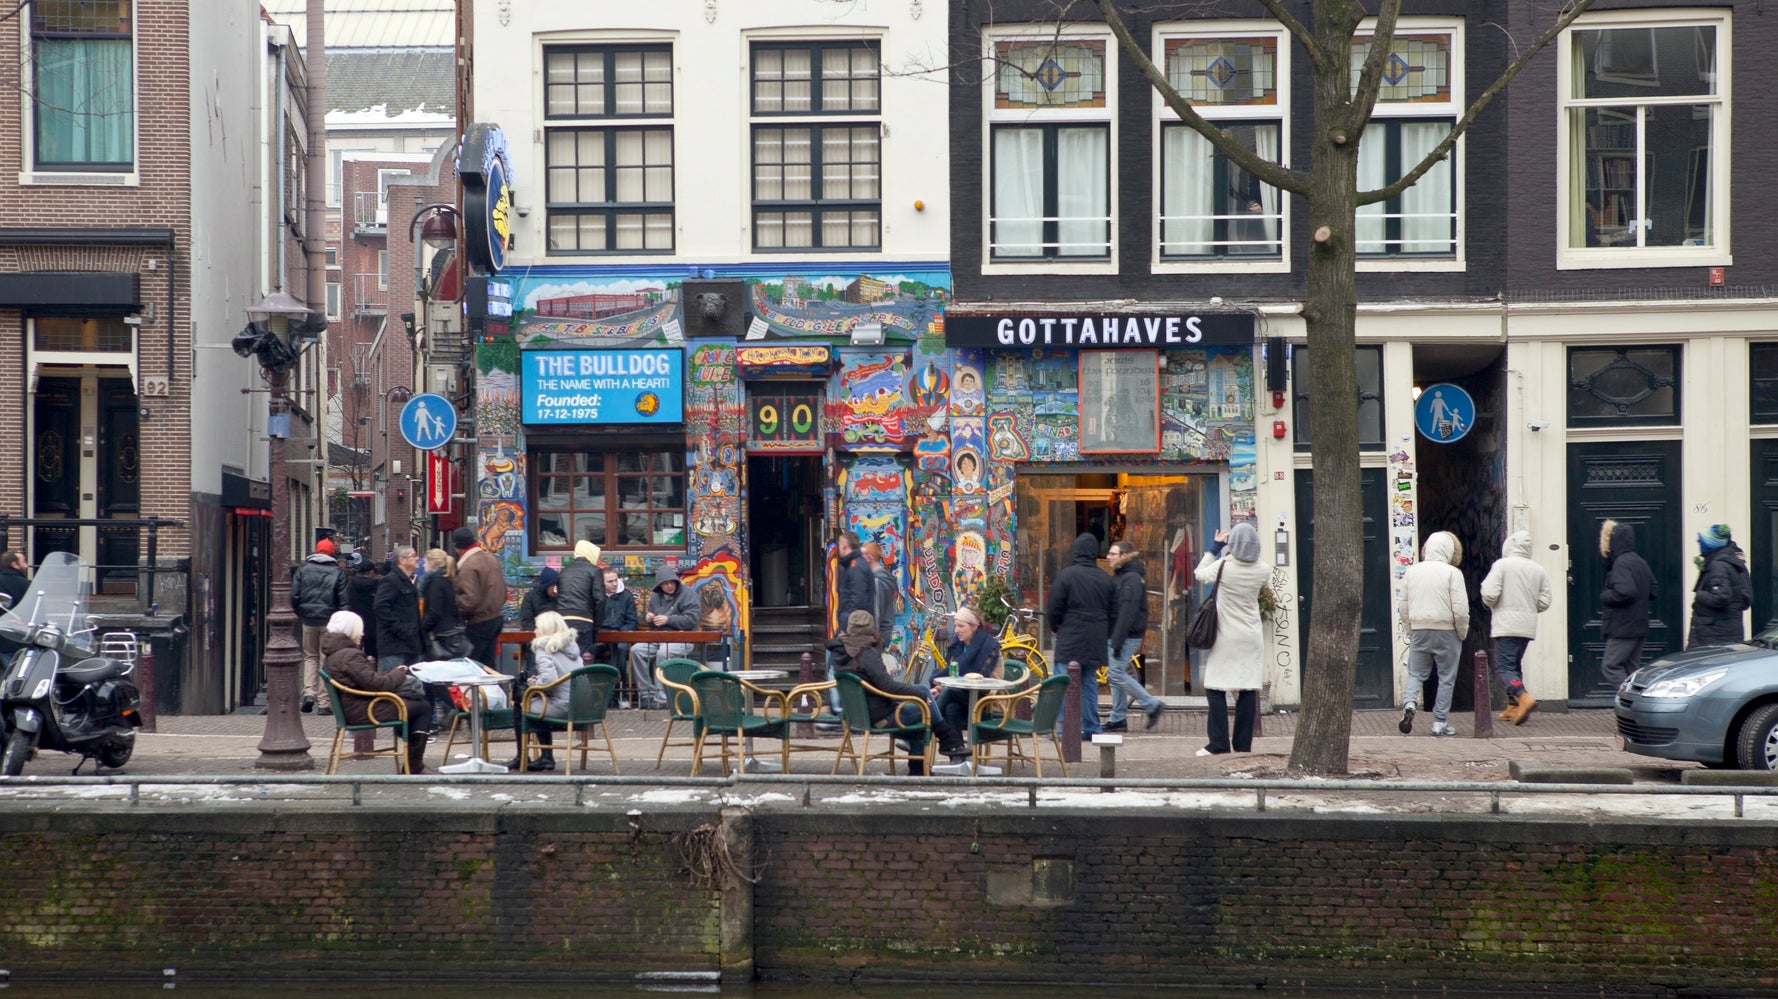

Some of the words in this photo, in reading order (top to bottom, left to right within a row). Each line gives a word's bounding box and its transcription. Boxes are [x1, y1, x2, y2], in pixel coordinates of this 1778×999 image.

[997, 316, 1203, 345] GOTTAHAVES
[536, 356, 576, 376] THE
[580, 354, 670, 376] BULLDOG
[694, 350, 734, 365] ORANGE
[694, 366, 732, 381] JUICE
[147, 381, 166, 394] 92
[537, 379, 559, 390] THE
[561, 379, 592, 390] NAME
[594, 379, 620, 390] WITH
[622, 379, 630, 390] A
[632, 378, 670, 390] HEART!
[536, 394, 602, 407] Founded:
[537, 408, 598, 419] 17-12-1975
[759, 404, 812, 434] 90
[1038, 423, 1078, 438] CANADA
[1693, 501, 1712, 514] 86
